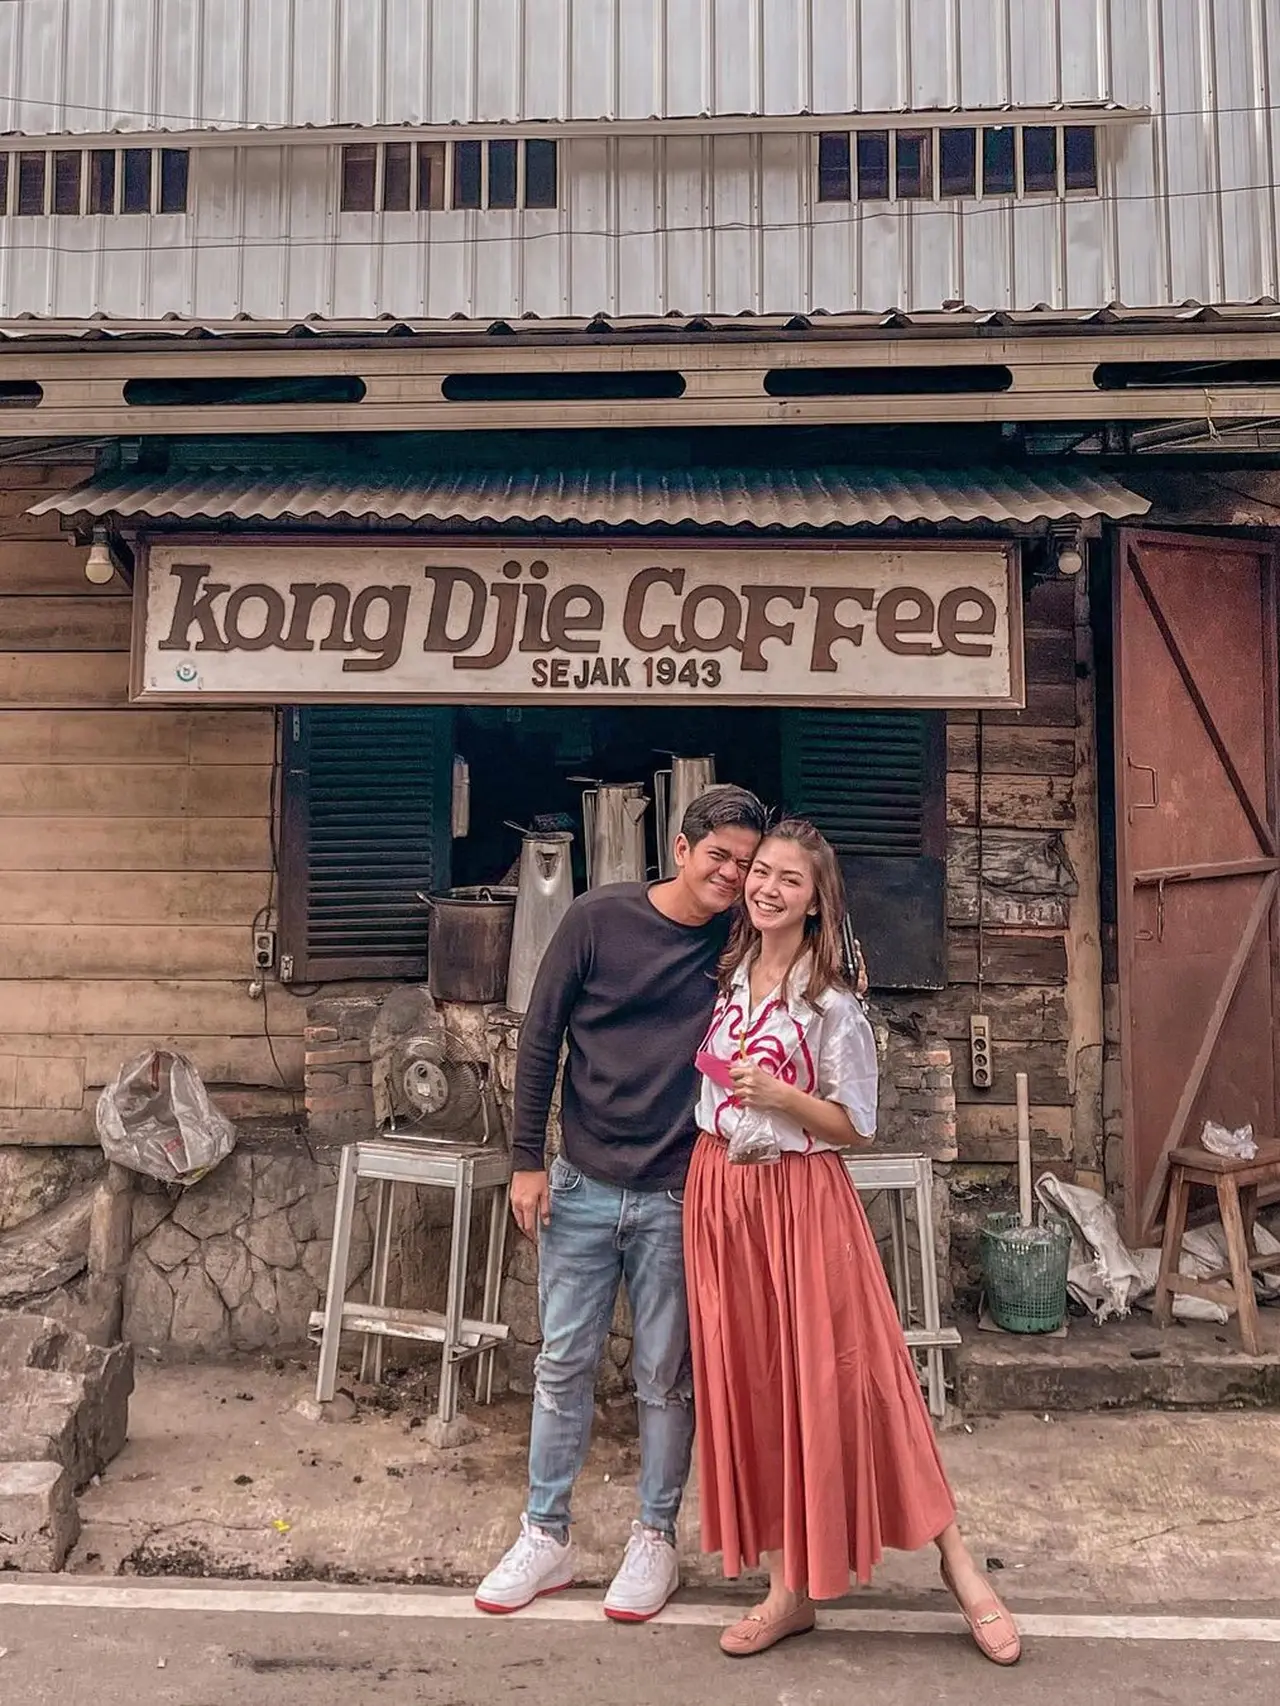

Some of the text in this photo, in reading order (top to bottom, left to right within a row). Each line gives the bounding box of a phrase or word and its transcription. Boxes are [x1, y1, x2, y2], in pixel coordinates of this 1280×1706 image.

[424, 560, 604, 669] Djie
[532, 657, 721, 688] SEJAK 1943
